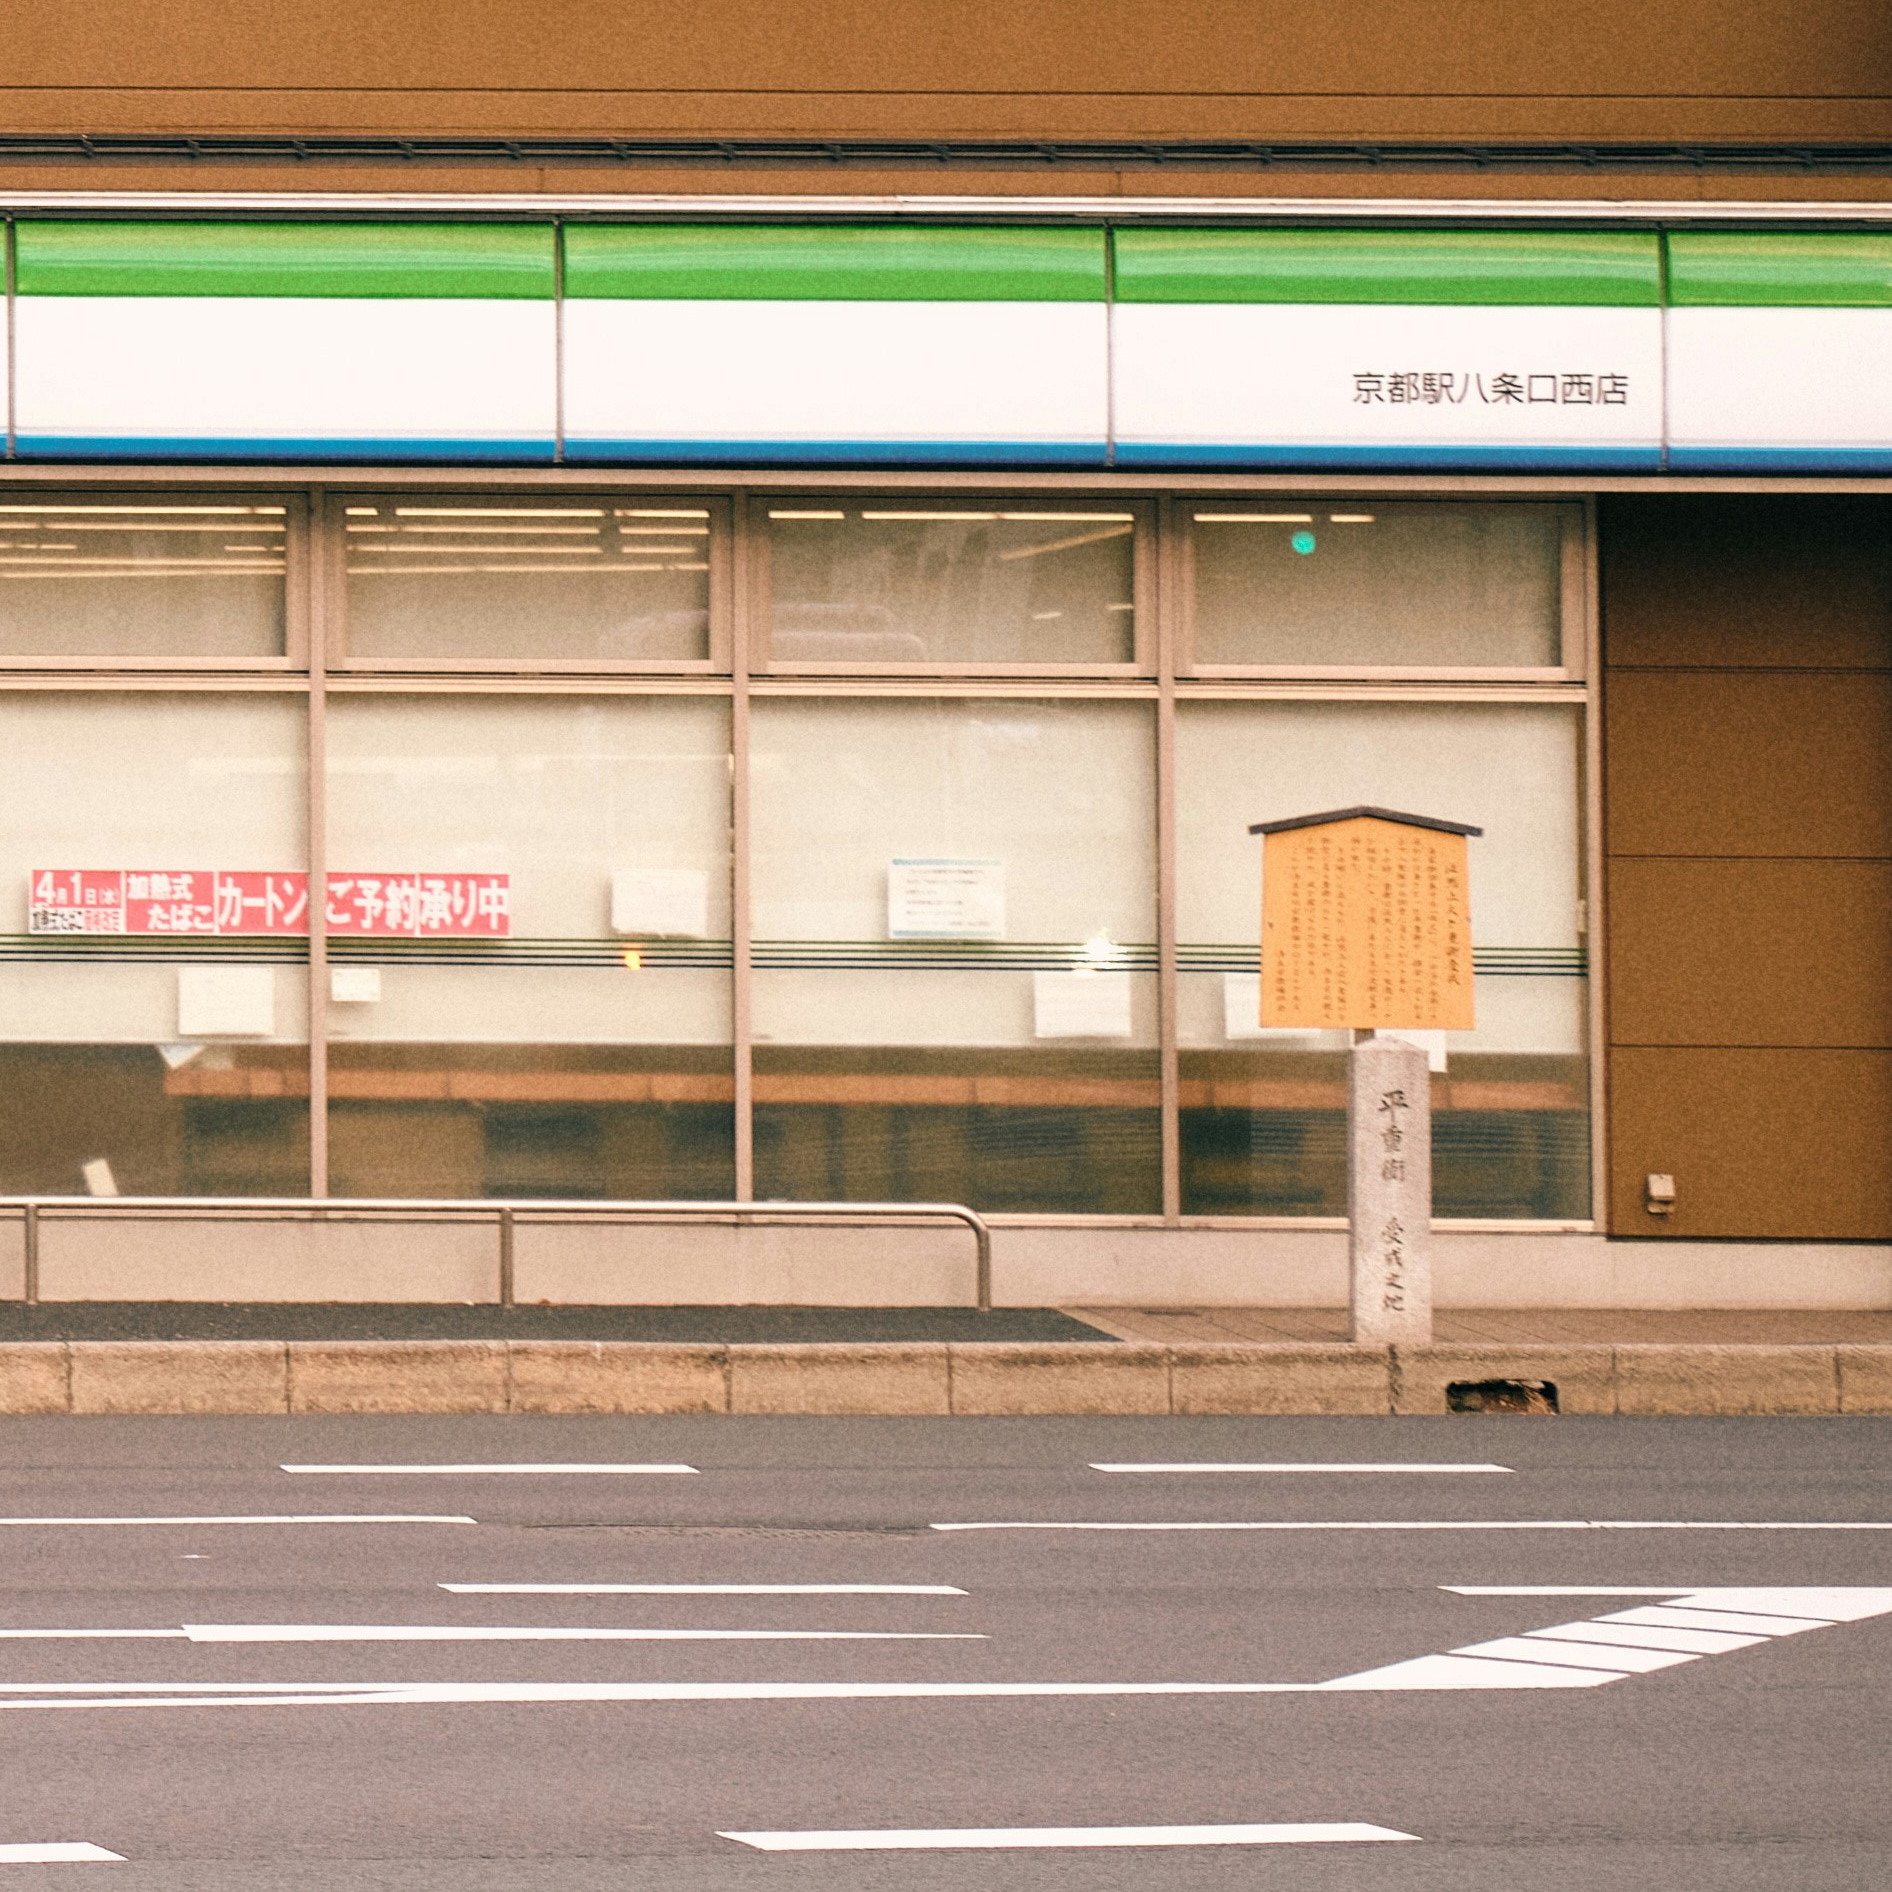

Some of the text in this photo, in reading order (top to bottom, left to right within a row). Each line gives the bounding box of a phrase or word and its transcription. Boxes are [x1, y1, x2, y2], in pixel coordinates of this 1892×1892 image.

[1352, 372, 1629, 406] 京都駅八条口西店
[126, 874, 194, 900] 加熱式
[218, 876, 307, 928] カートン
[147, 904, 214, 931] たばこ
